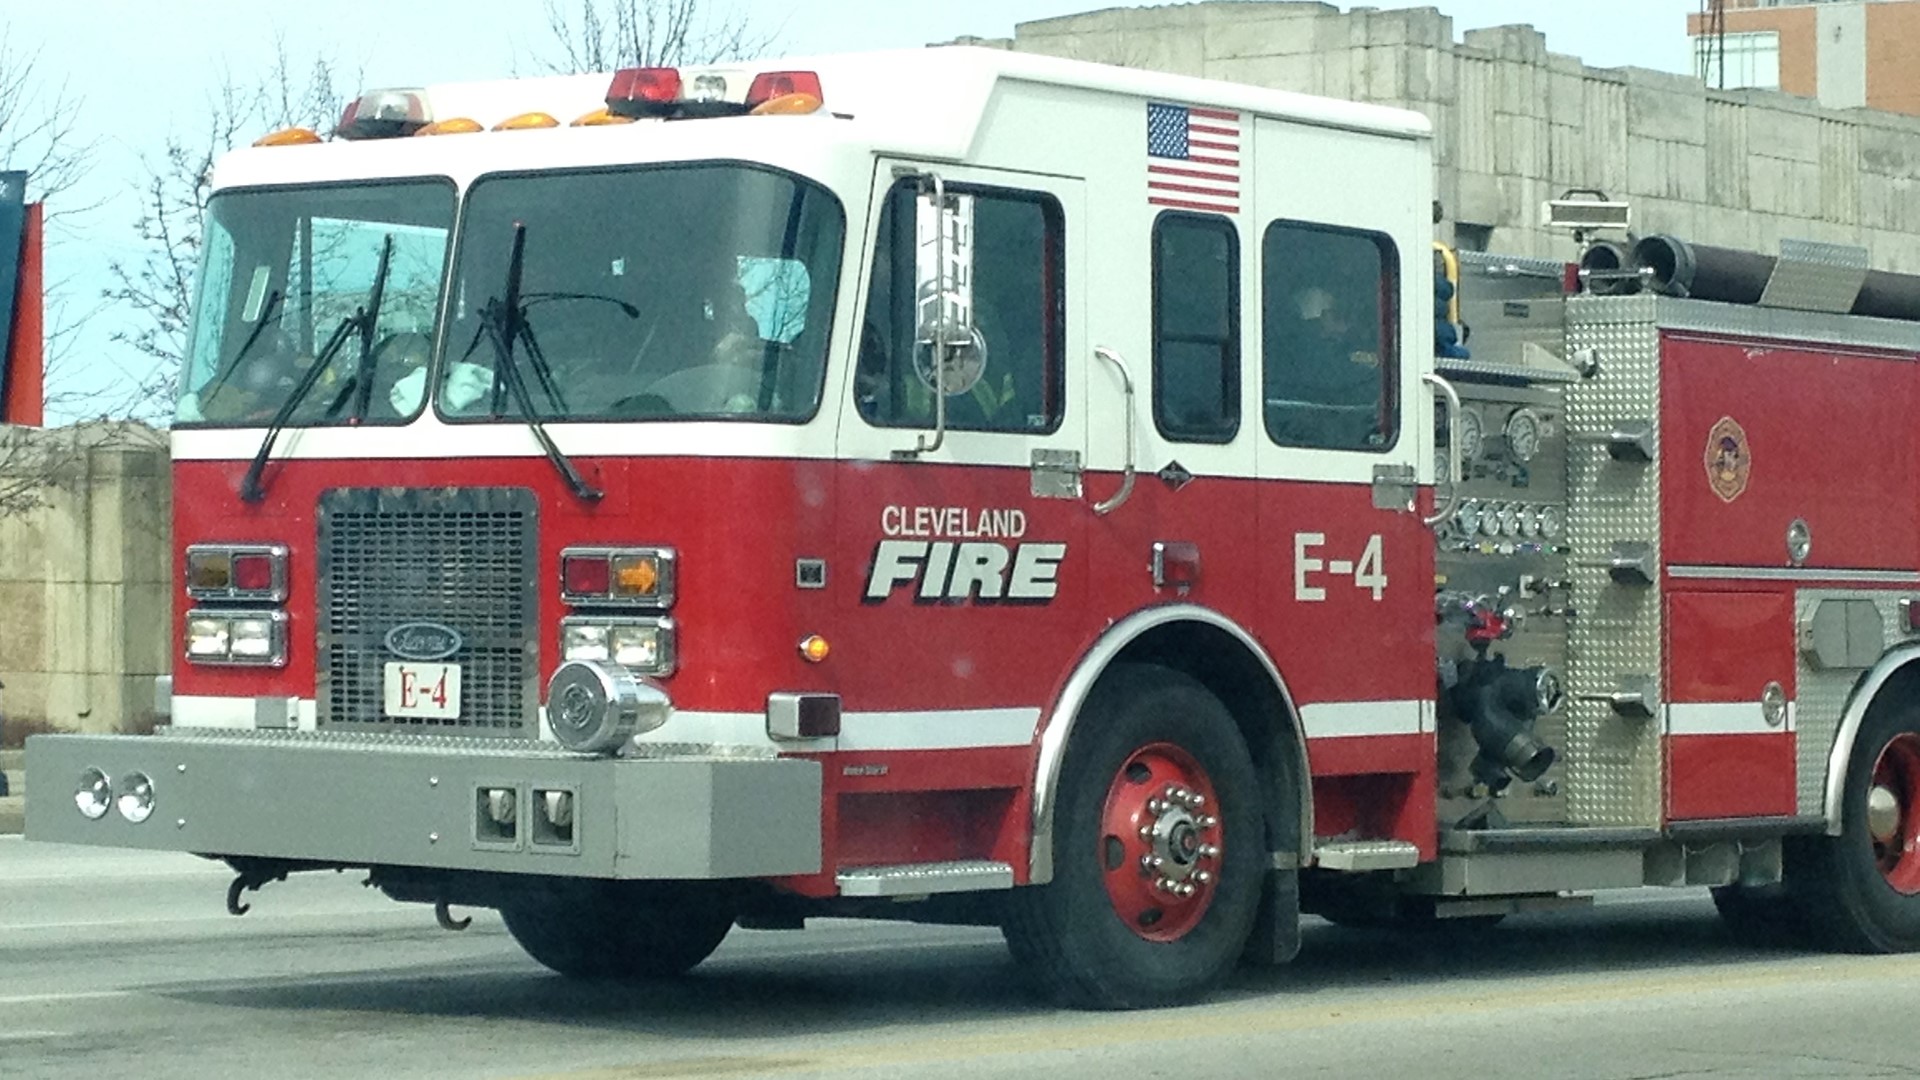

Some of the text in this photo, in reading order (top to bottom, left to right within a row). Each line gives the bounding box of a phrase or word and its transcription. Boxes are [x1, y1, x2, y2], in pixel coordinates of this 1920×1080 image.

[881, 505, 1027, 537] CLEVELAND
[863, 540, 1067, 602] FIRE
[1295, 532, 1388, 601] E-4
[400, 669, 447, 709] E-4
